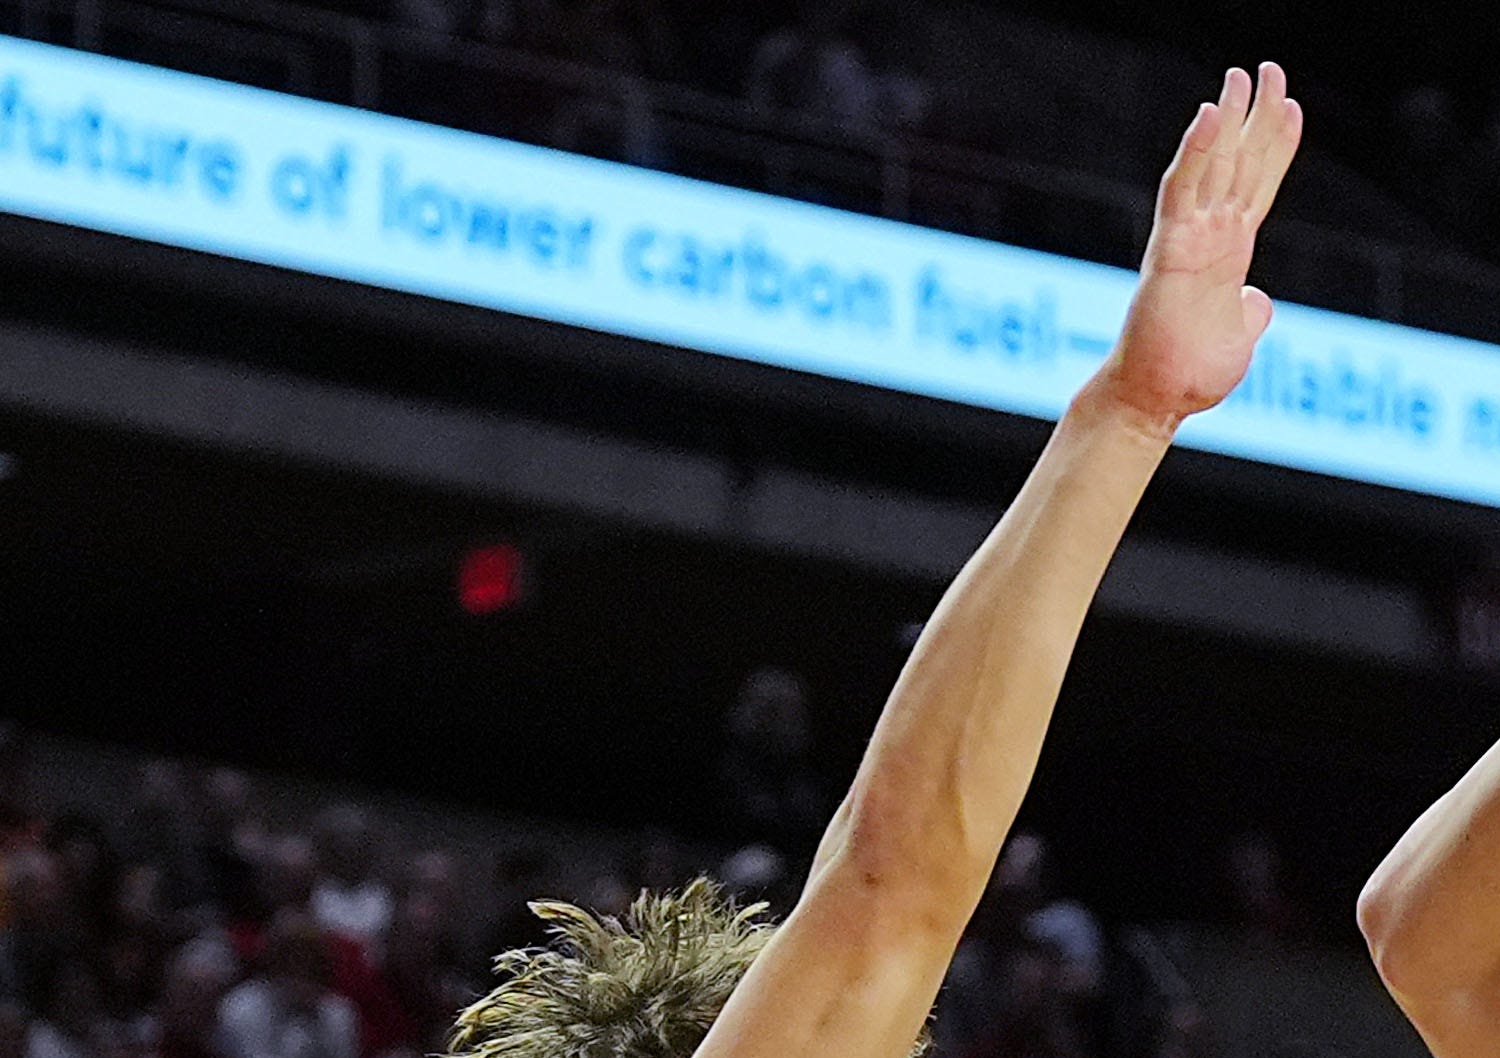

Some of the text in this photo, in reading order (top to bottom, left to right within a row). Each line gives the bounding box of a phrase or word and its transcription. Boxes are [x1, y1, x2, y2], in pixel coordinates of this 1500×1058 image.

[0, 76, 238, 200] future
[270, 142, 350, 218] of
[381, 154, 596, 268] lower
[624, 225, 896, 325] carbon
